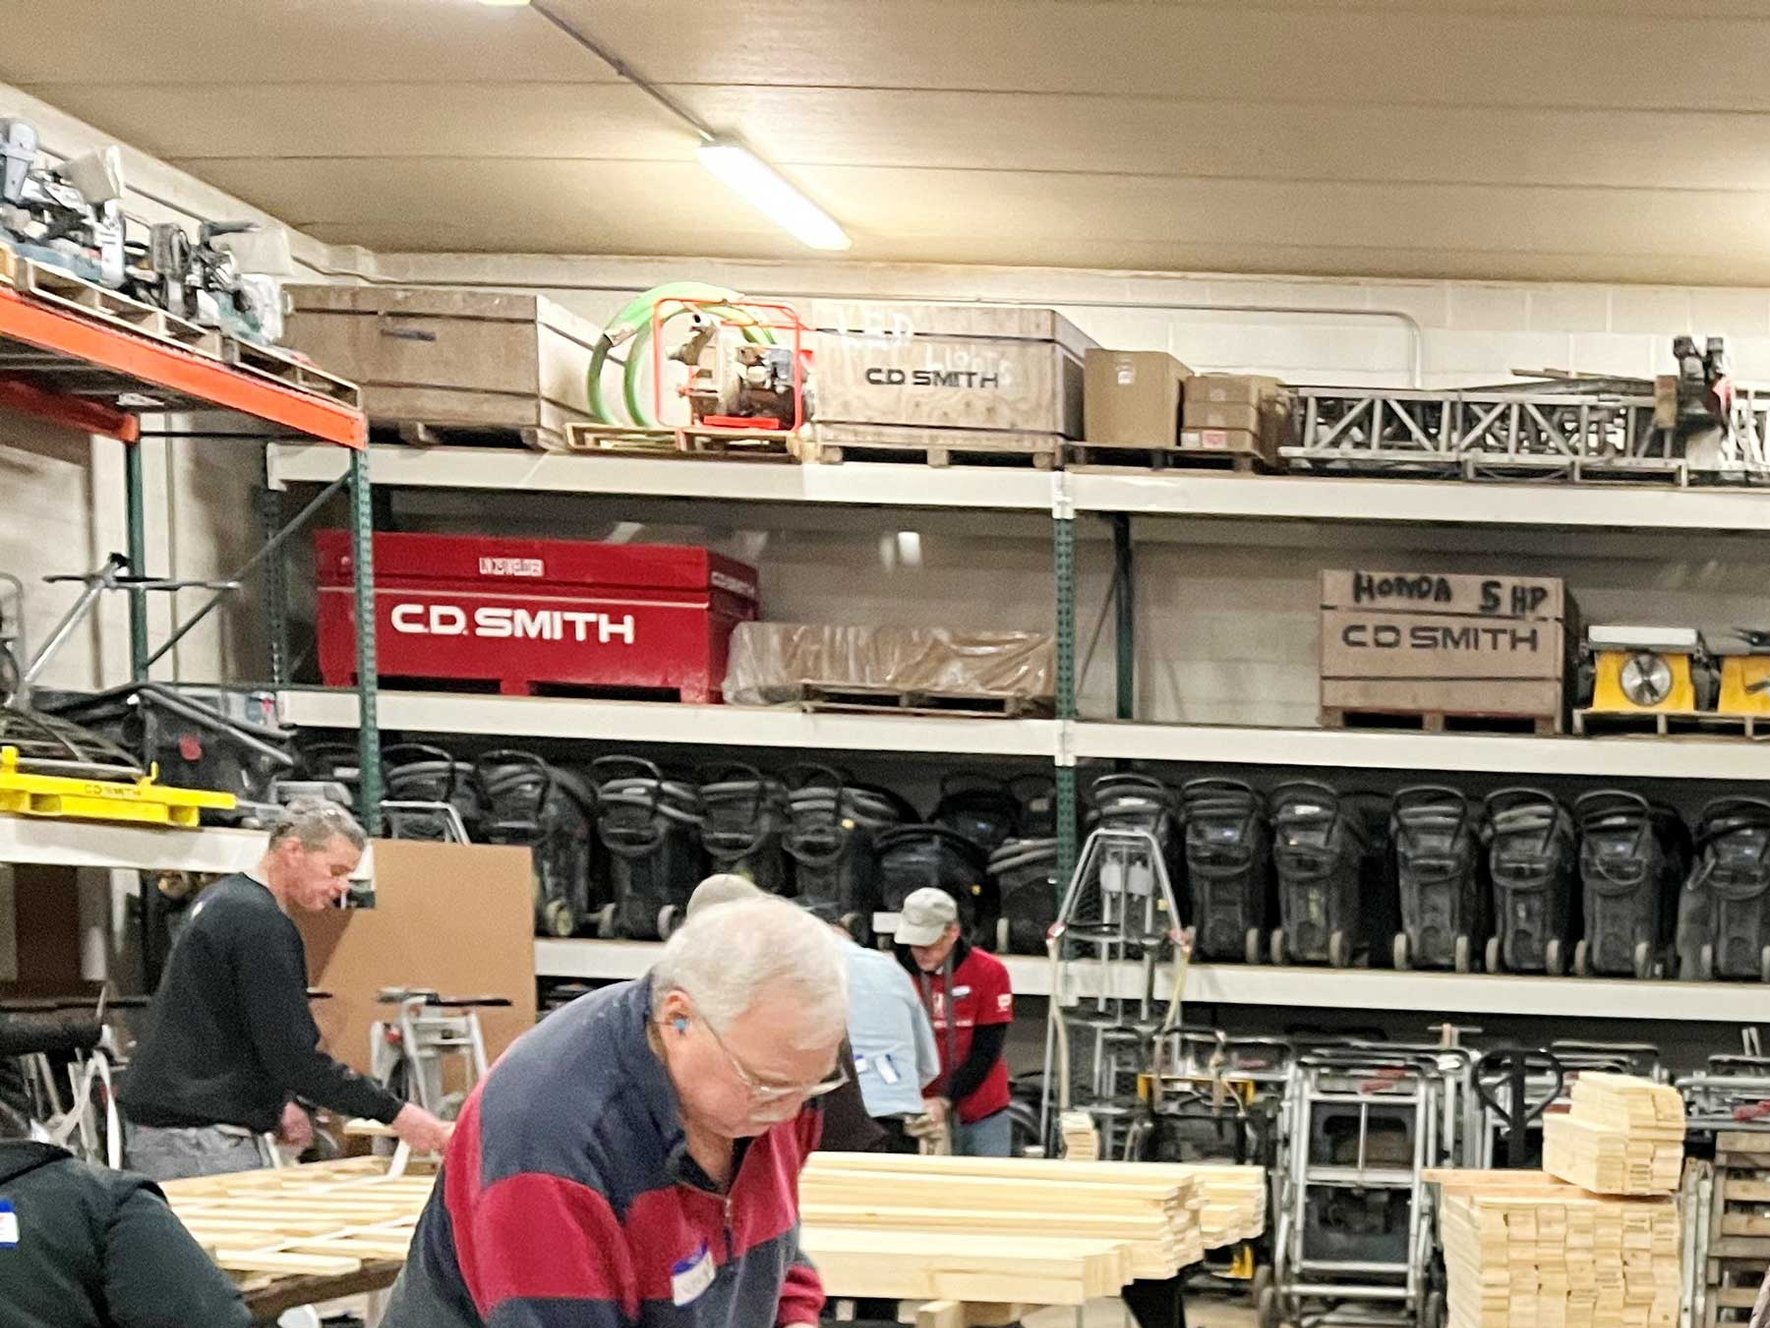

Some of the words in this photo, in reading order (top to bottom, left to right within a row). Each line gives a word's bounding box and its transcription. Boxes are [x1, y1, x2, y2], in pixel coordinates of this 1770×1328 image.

[912, 369, 999, 389] SMITH
[474, 606, 635, 645] SMITH
[1409, 625, 1539, 652] SMITH
